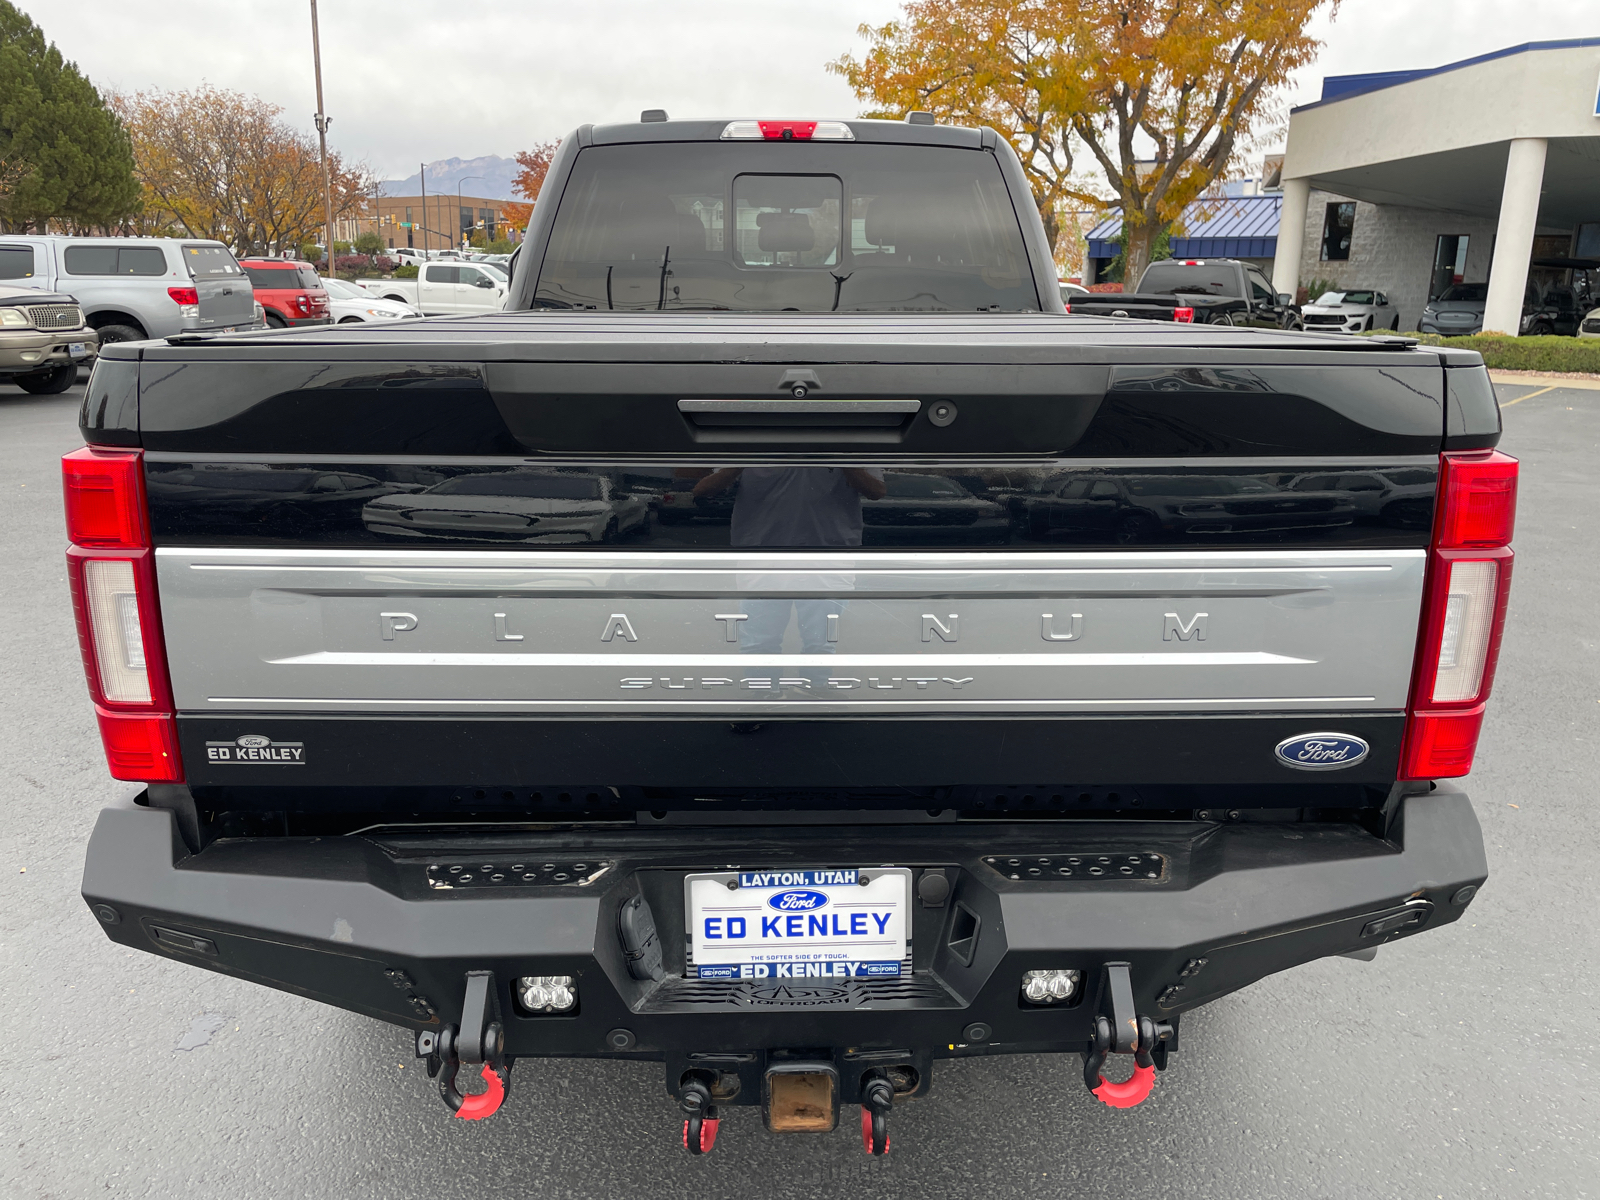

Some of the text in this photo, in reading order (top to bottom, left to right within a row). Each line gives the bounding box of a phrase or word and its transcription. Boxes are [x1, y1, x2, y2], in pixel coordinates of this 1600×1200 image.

[380, 611, 1209, 643] PLATINUM
[620, 677, 974, 690] SUPER DUTY
[244, 738, 263, 746] Ford
[207, 748, 302, 760] ED KENLEY
[1297, 740, 1351, 761] Ford
[741, 871, 856, 887] LAYTON, UTAH
[779, 893, 816, 909] Ford
[704, 913, 892, 939] ED KENLEY
[740, 964, 769, 978] ED
[776, 962, 860, 978] KENLEY
